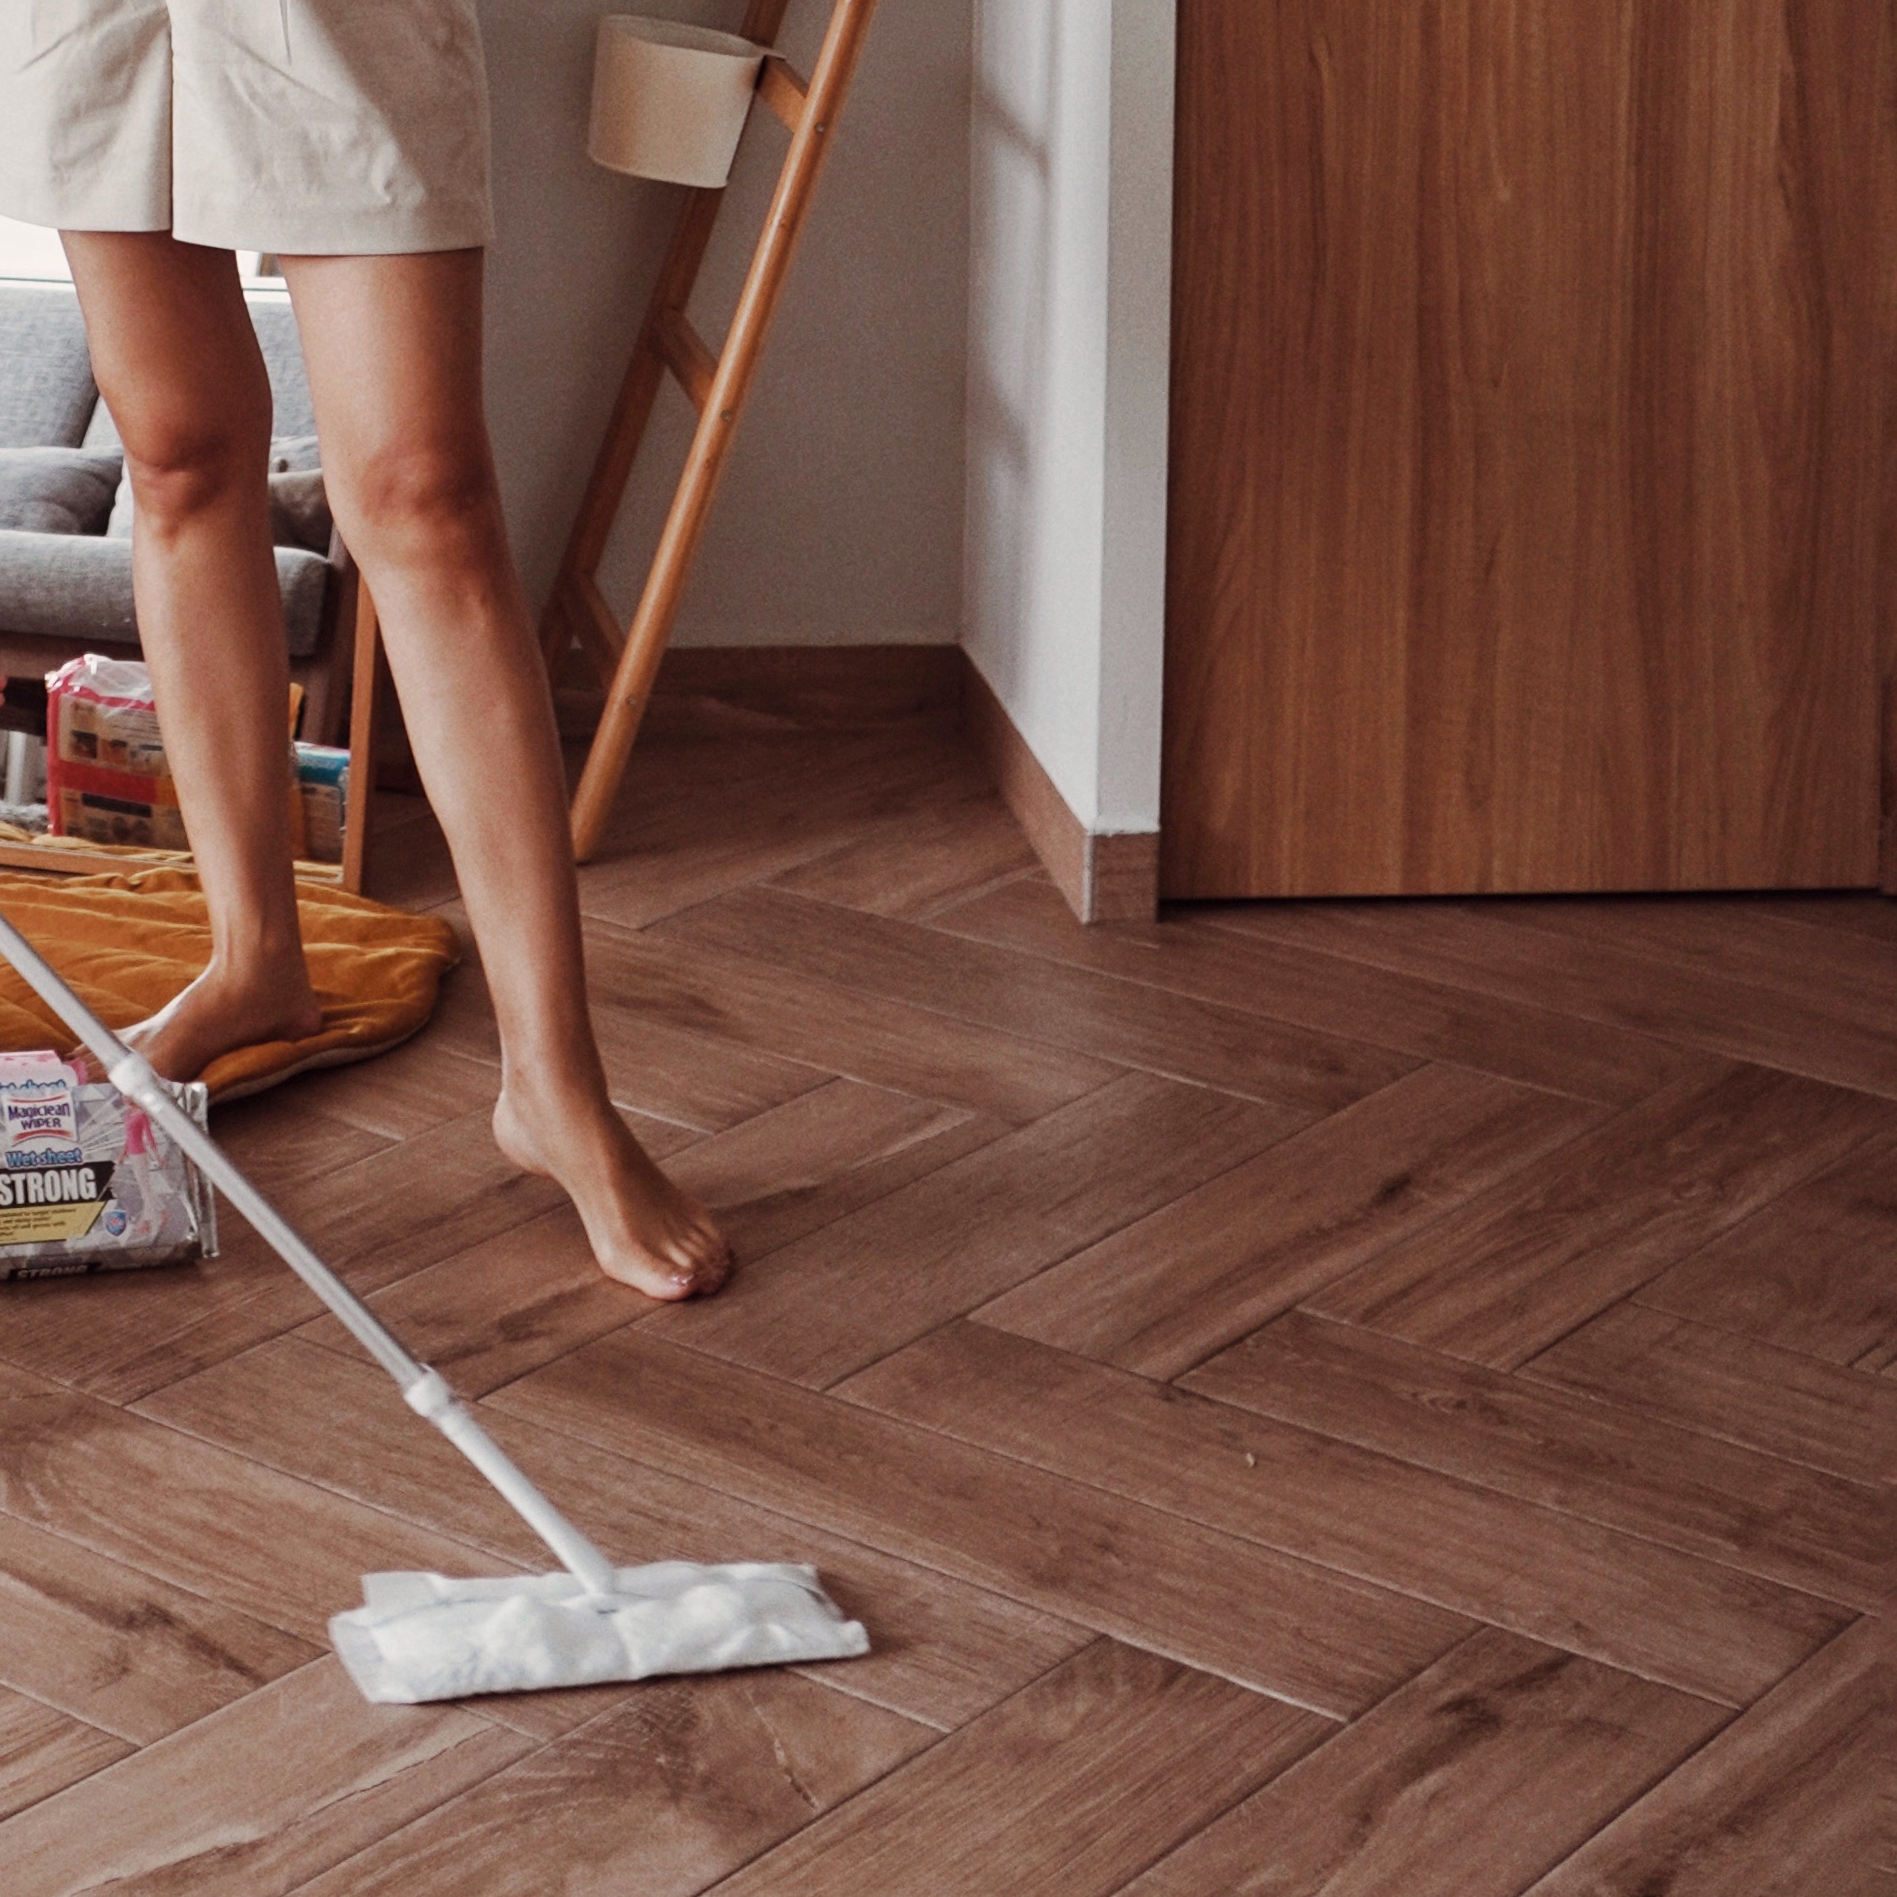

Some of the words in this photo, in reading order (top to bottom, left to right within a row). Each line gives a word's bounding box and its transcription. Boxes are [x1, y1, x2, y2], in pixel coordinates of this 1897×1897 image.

[7, 1102, 71, 1121] Magiclean
[21, 1117, 62, 1130] WIPER
[6, 1150, 38, 1168] Wet
[40, 1147, 82, 1164] sheet
